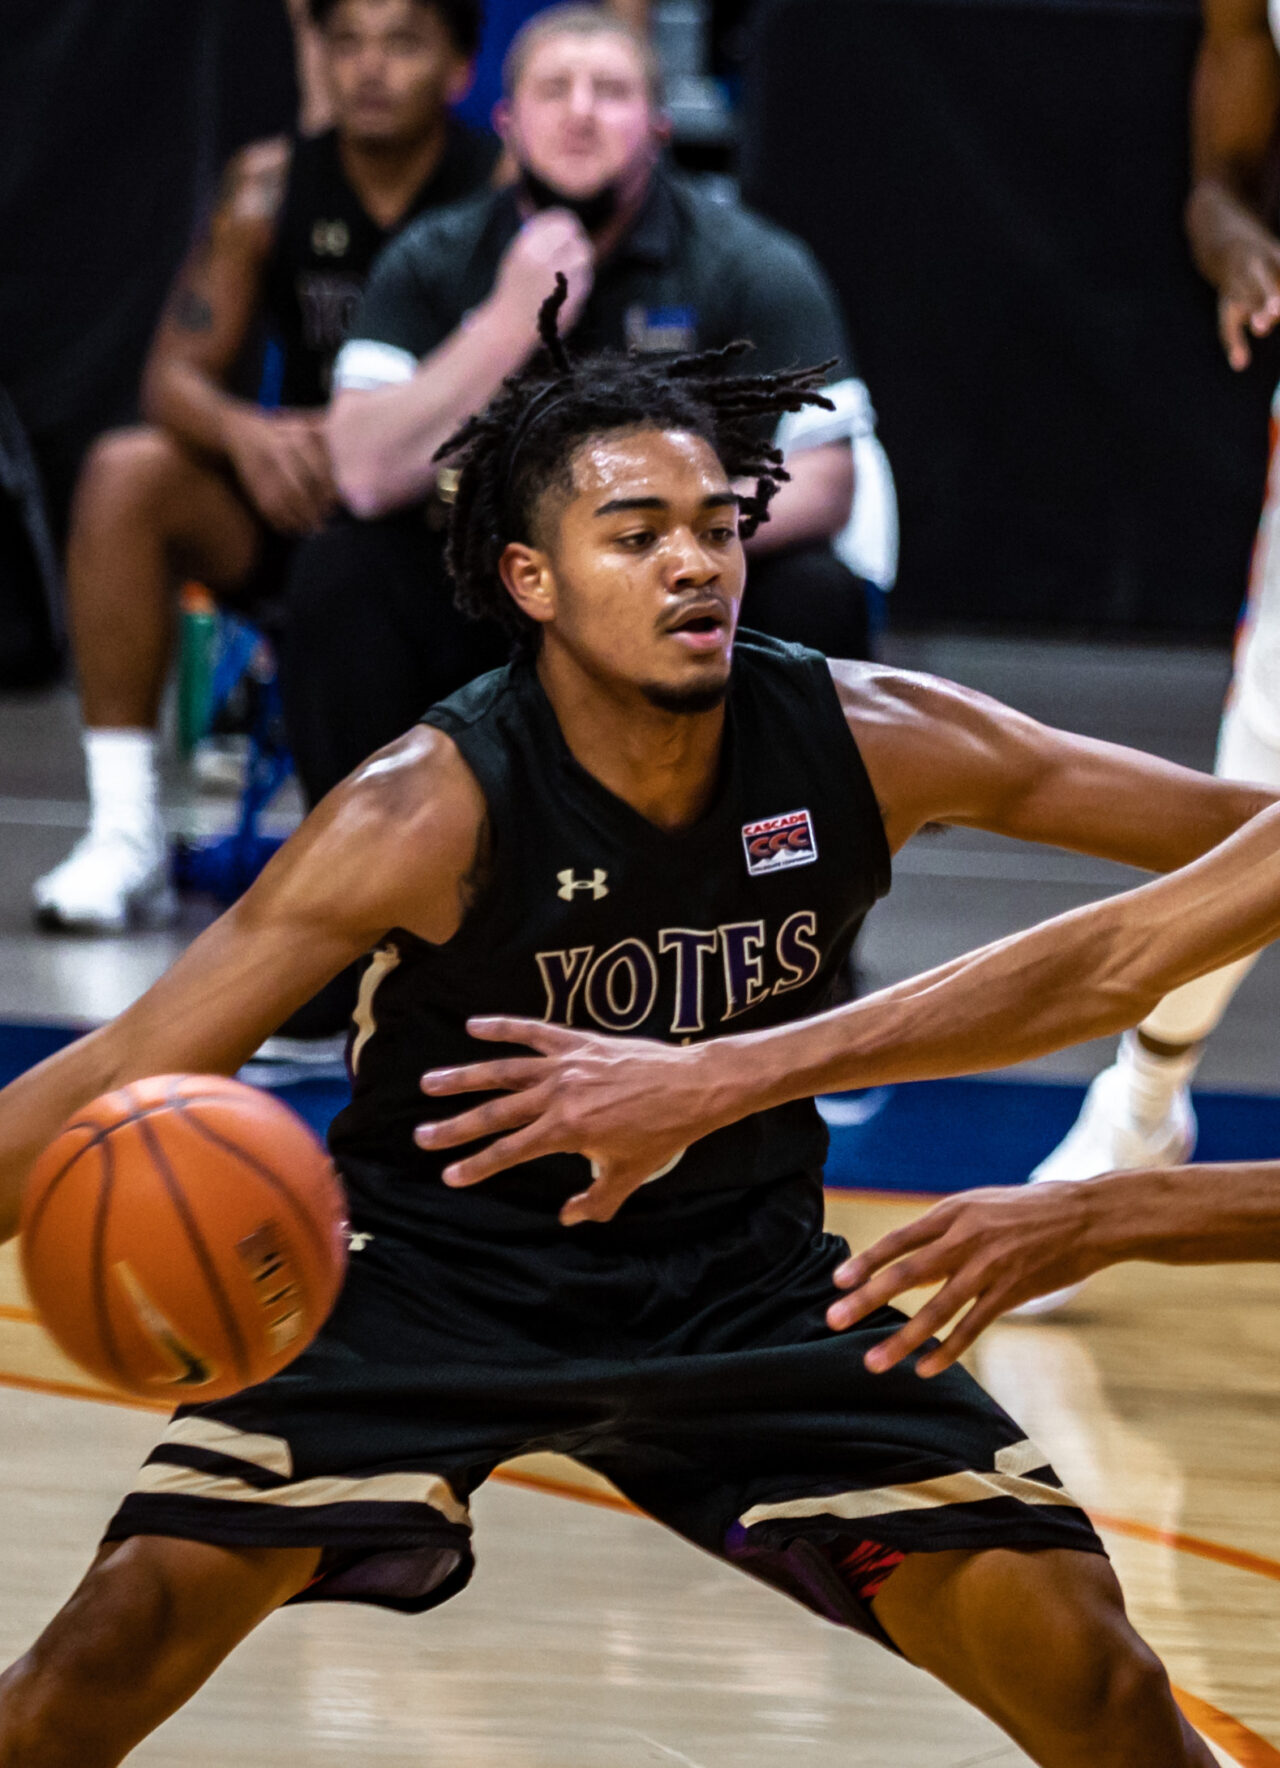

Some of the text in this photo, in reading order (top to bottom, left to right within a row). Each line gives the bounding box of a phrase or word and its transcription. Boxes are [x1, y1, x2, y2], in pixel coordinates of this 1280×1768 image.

[744, 812, 807, 835] CASCADE
[749, 827, 809, 857] CCC
[534, 910, 820, 1033] YOTES
